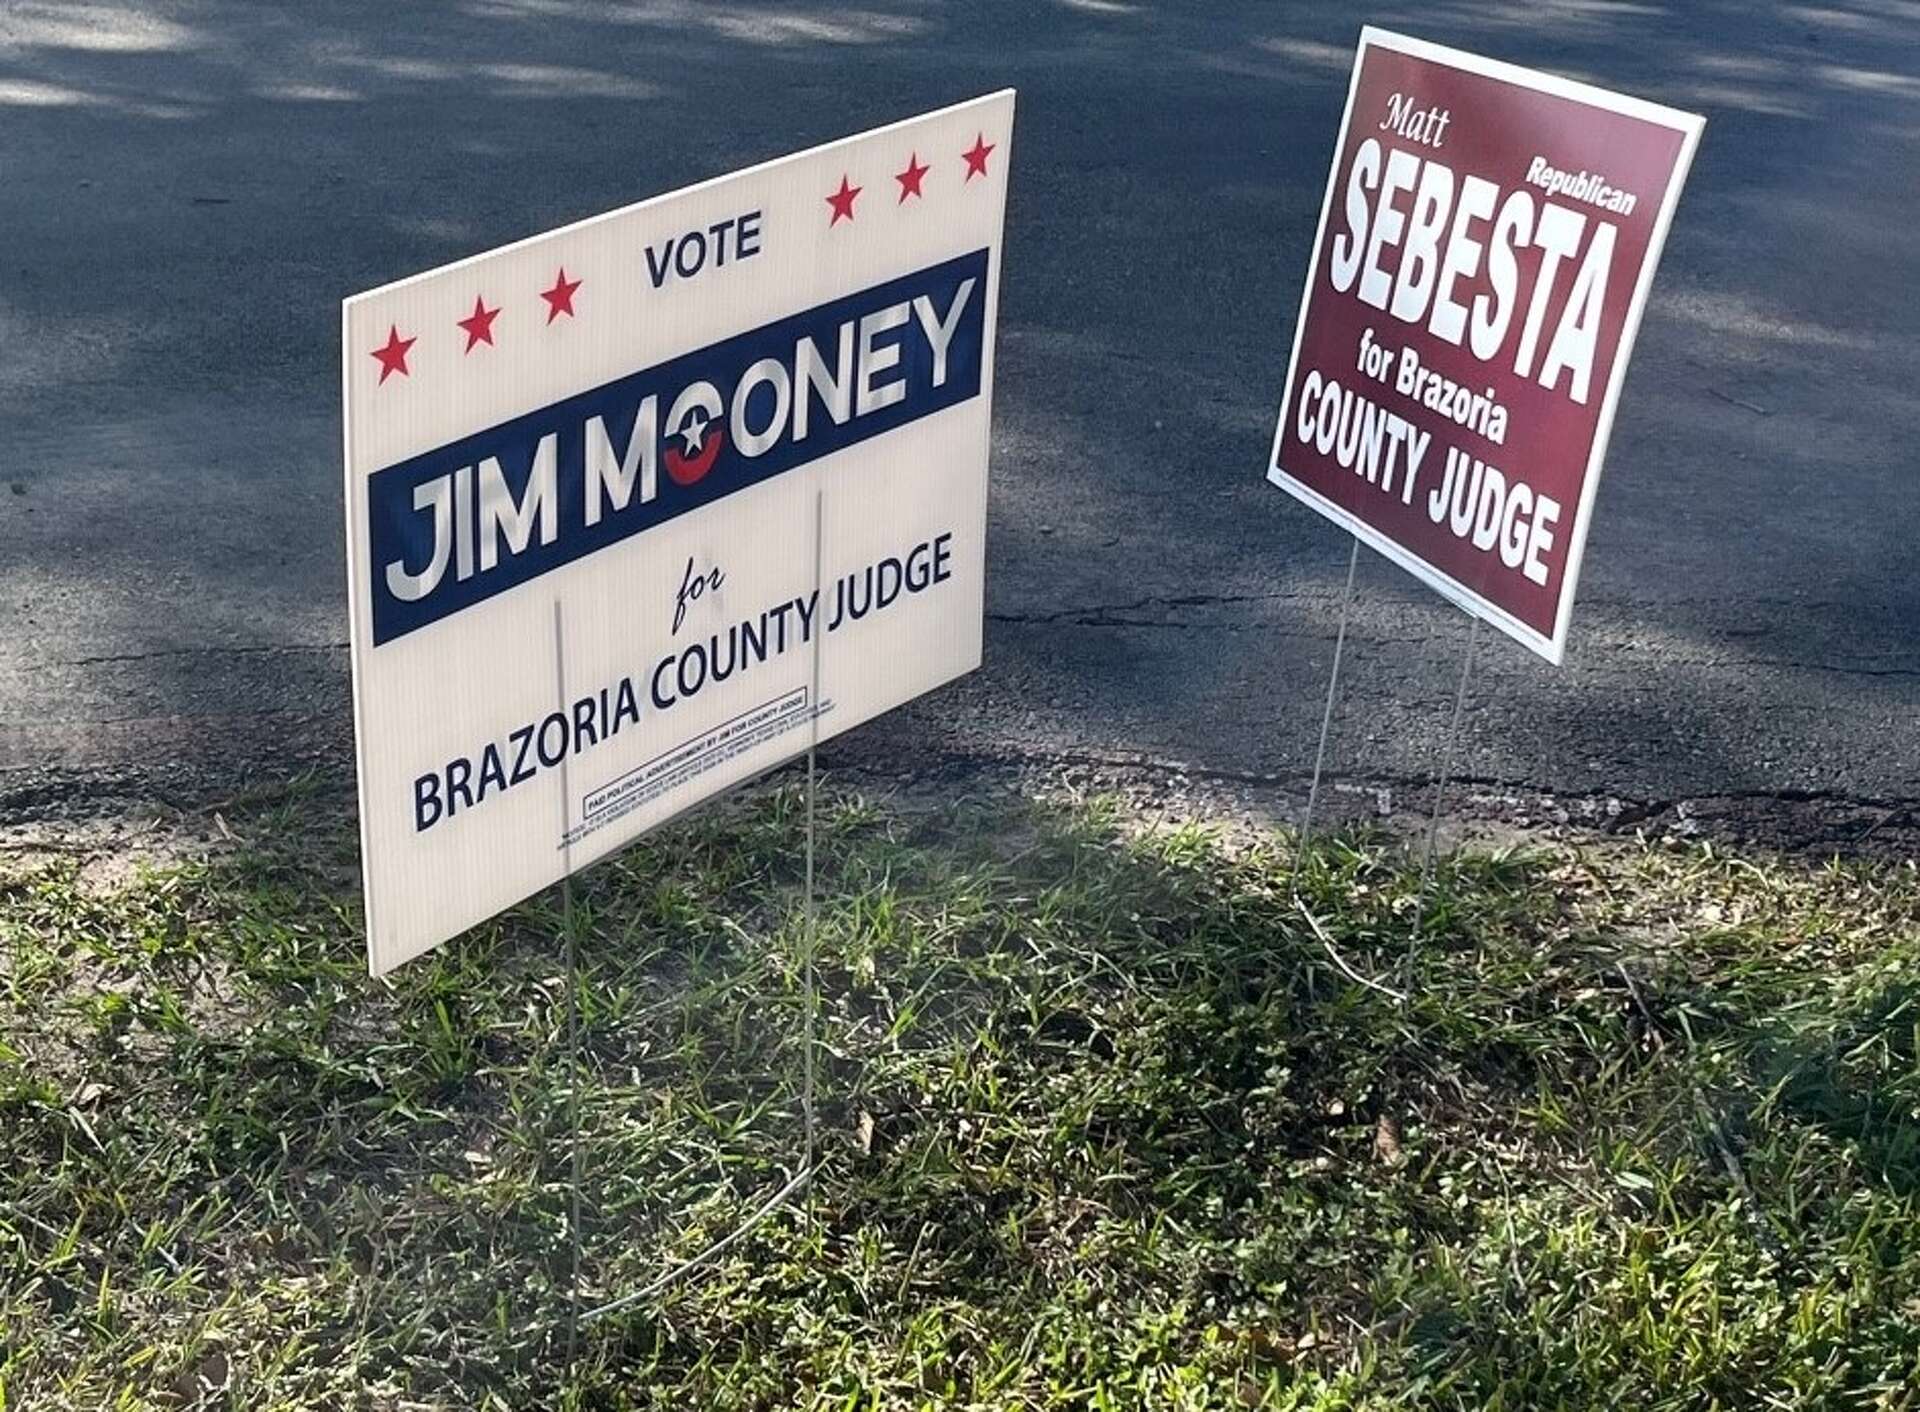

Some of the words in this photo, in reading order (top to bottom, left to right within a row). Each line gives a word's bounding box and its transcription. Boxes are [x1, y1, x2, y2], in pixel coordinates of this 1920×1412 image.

[1379, 92, 1452, 148] Matt
[1525, 156, 1637, 216] Republican
[644, 210, 763, 289] VOTE
[1329, 137, 1618, 405] SEBESTA
[386, 432, 559, 603] JIM
[584, 277, 976, 527] MOONEY
[1356, 327, 1395, 383] for
[1396, 346, 1508, 445] Brazoria
[1297, 370, 1432, 506] COUNTY
[1428, 446, 1562, 587] JUDGE
[671, 556, 727, 636] for
[414, 677, 640, 833] BRAZORIA
[650, 589, 821, 710] COUNTY
[827, 531, 953, 632] JUDGE
[588, 794, 607, 811] PAID
[607, 776, 644, 800] POLITICAL
[706, 736, 718, 748] BY
[719, 728, 731, 741] JIM
[731, 720, 747, 734] FOR
[747, 706, 778, 727] COUNTY
[779, 695, 803, 713] JUDGE
